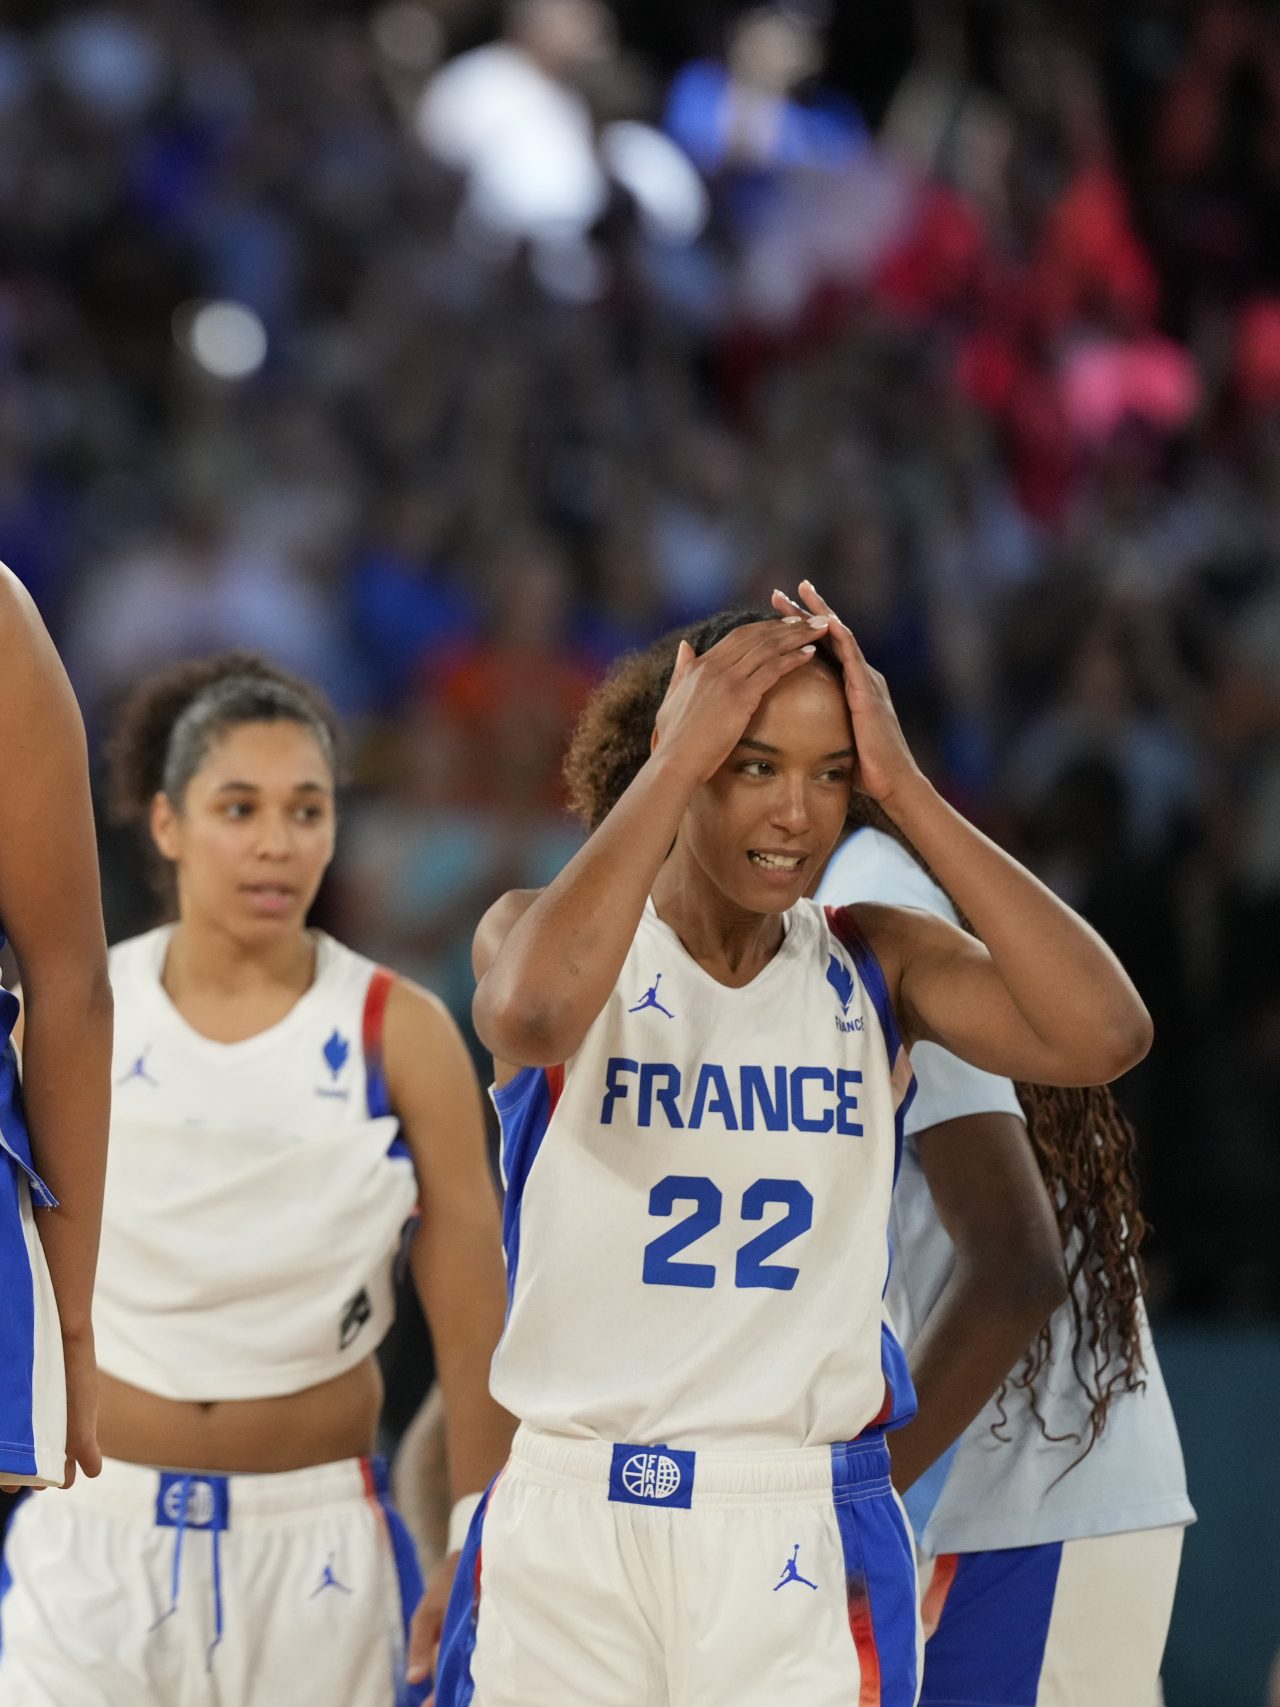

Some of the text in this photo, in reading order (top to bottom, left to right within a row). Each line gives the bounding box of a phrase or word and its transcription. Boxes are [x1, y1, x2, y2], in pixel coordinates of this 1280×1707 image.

[600, 1057, 864, 1137] FRANCE
[642, 1175, 814, 1291] 22
[643, 1454, 658, 1498] FRA
